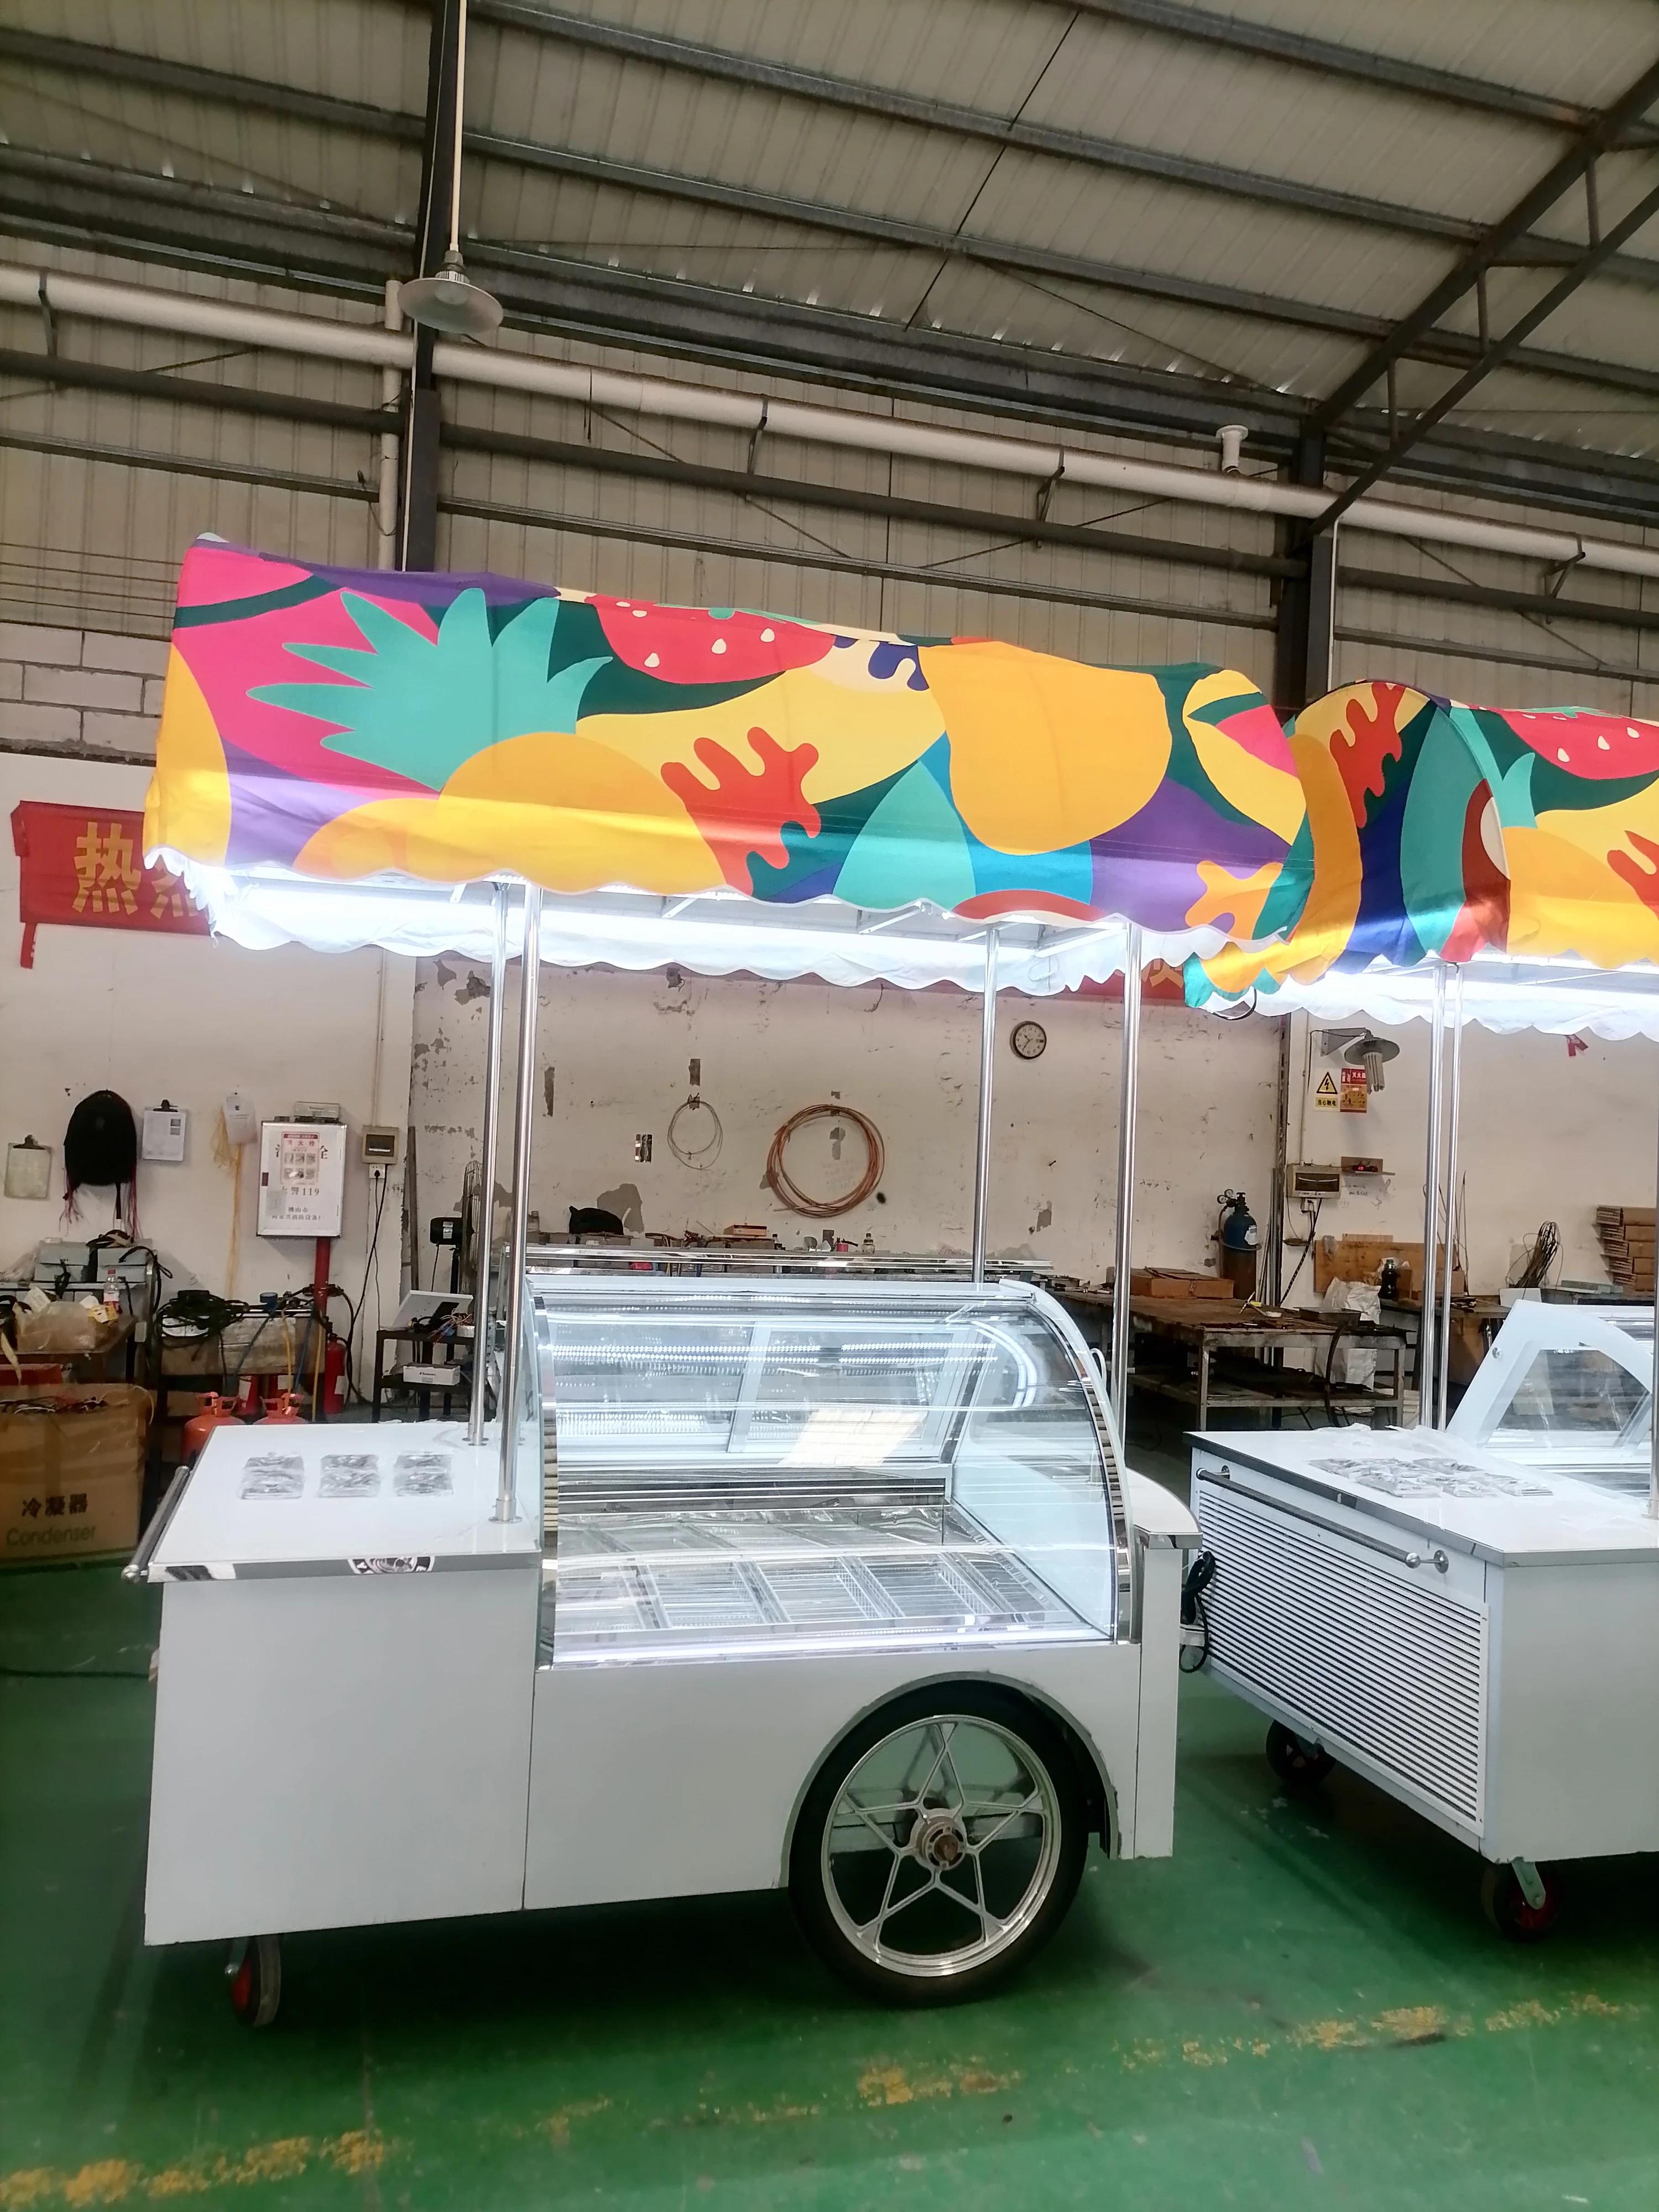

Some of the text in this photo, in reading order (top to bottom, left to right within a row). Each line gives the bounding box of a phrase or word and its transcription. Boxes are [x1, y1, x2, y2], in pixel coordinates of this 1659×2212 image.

[22, 1493, 88, 1519] 冷凝器
[6, 1526, 96, 1546] Condenser
